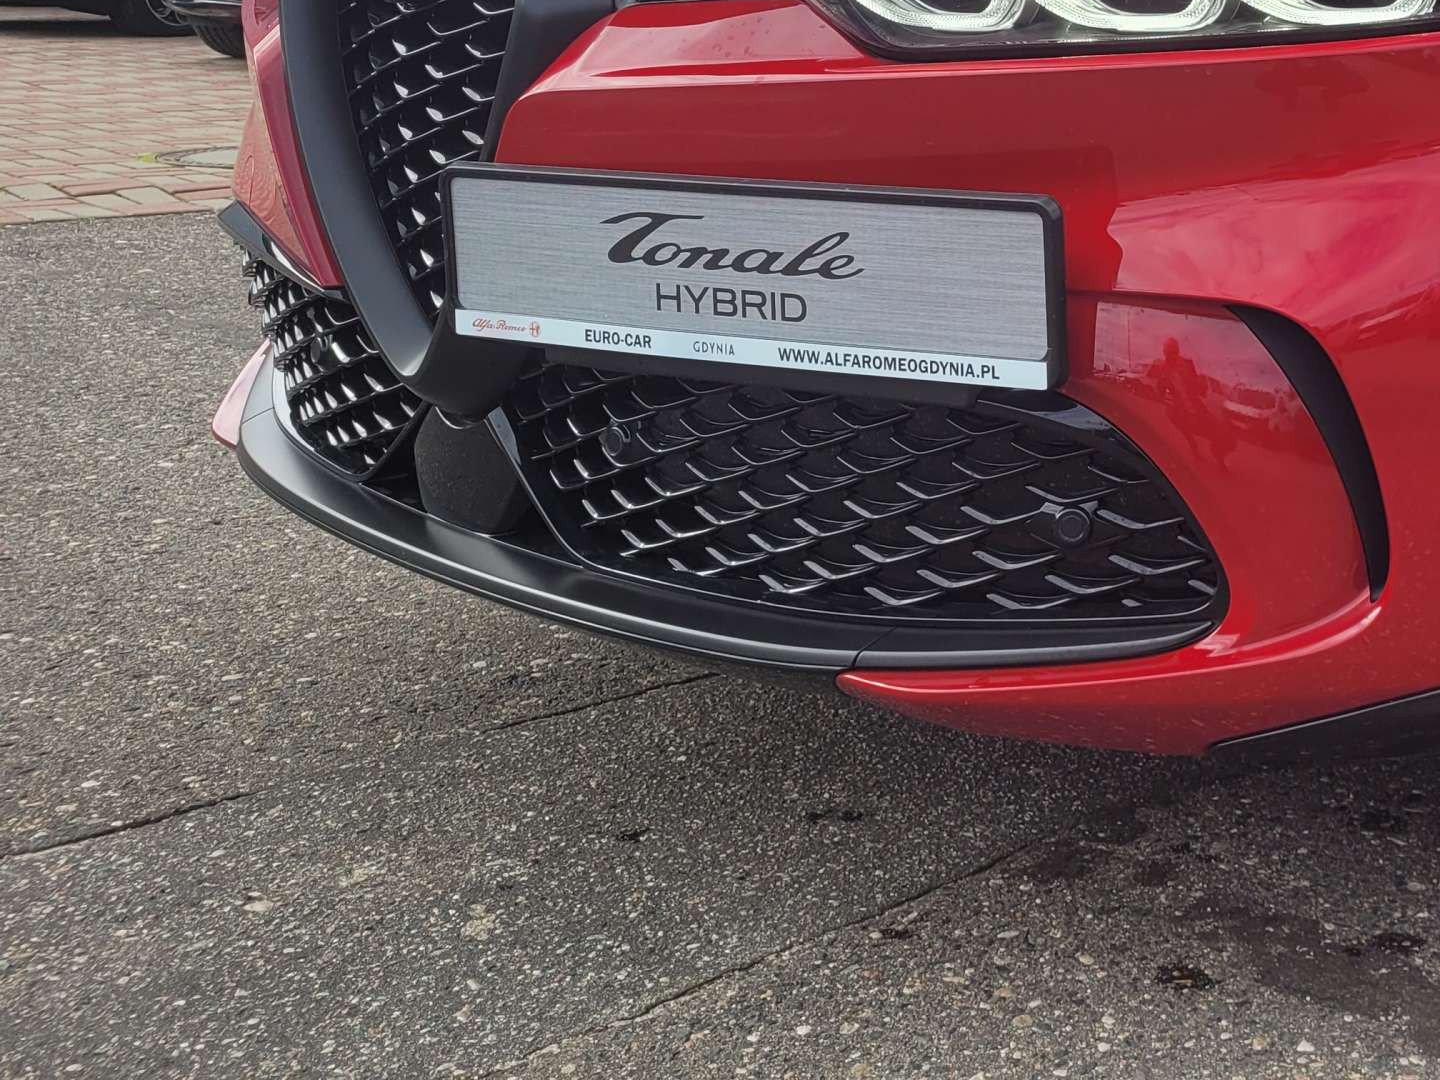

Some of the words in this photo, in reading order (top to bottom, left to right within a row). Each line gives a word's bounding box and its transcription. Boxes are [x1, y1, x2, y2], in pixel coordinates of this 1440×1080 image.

[600, 212, 865, 280] Tonale
[655, 283, 808, 323] HYBRID
[584, 329, 652, 349] EURO-CAR
[693, 340, 735, 356] GDYNIA
[778, 347, 1000, 380] WWW.ALFAROMEOGDYNIA.PL
